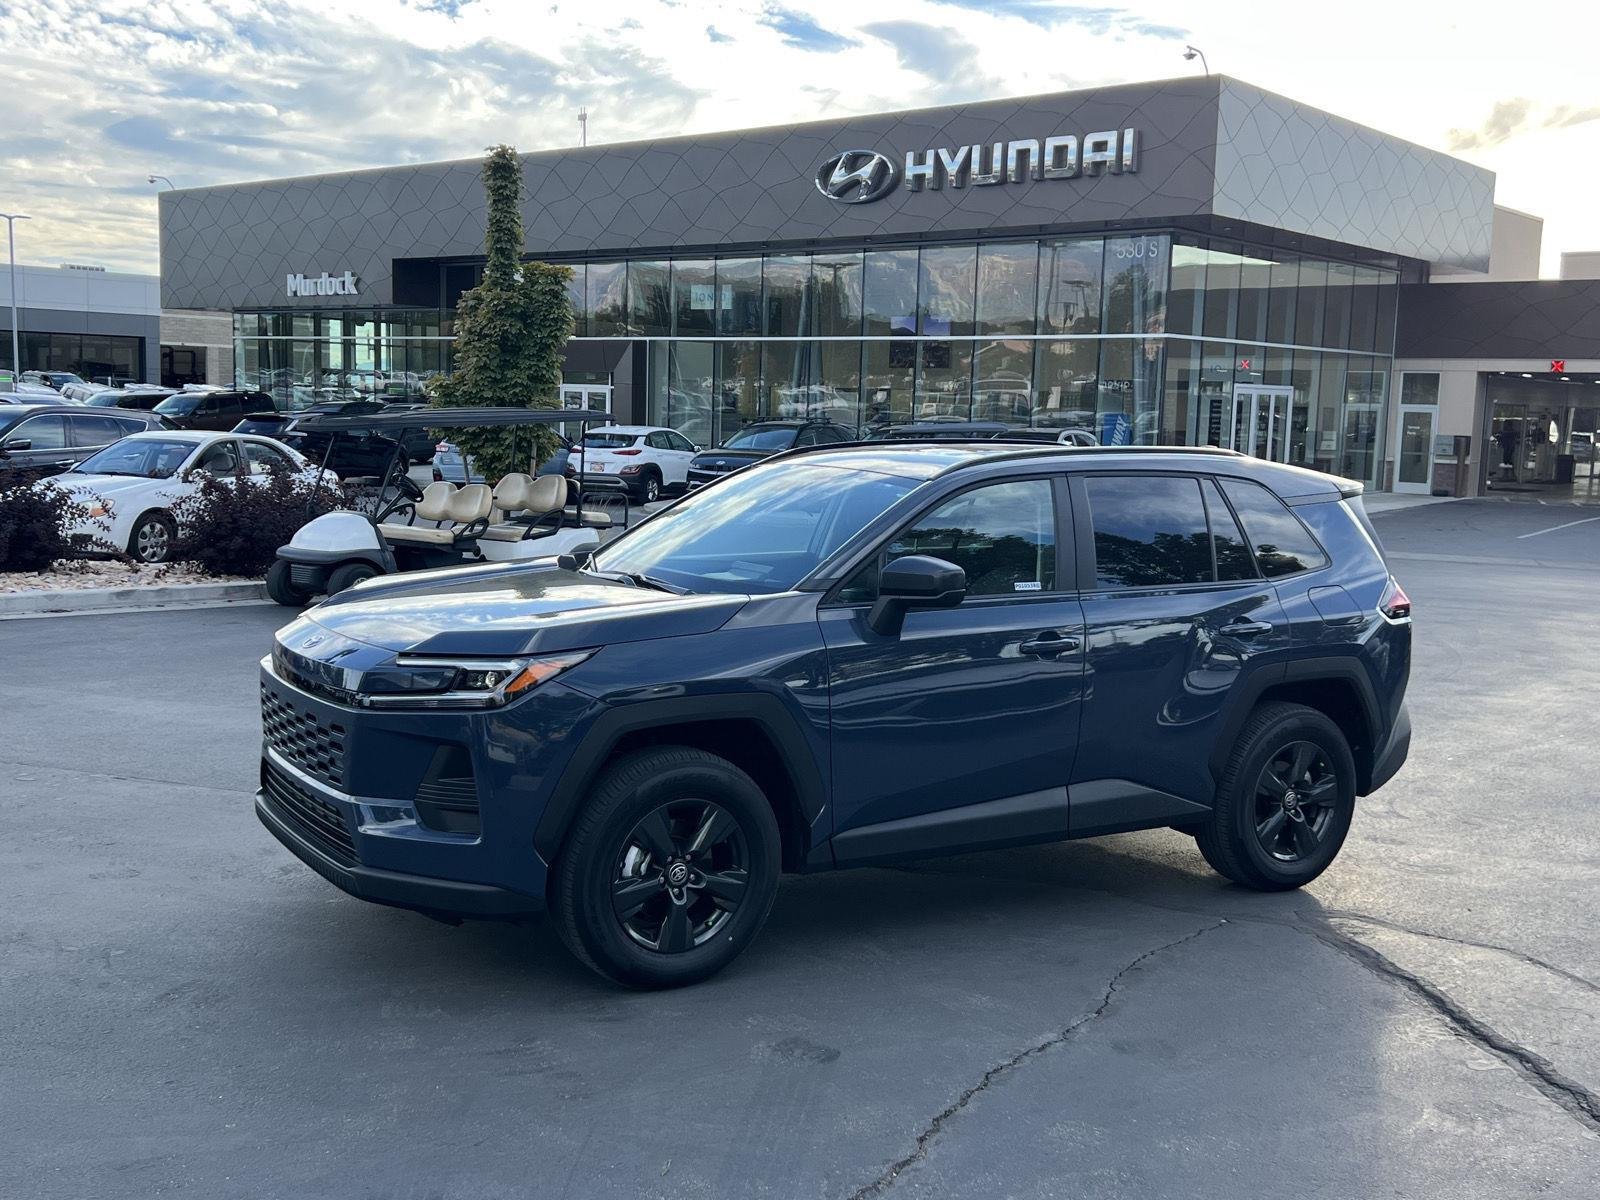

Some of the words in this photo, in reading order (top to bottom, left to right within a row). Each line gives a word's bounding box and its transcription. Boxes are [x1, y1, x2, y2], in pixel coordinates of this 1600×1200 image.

[905, 128, 1137, 191] HYUNDAI
[1148, 240, 1158, 257] S
[286, 270, 359, 297] Murdock
